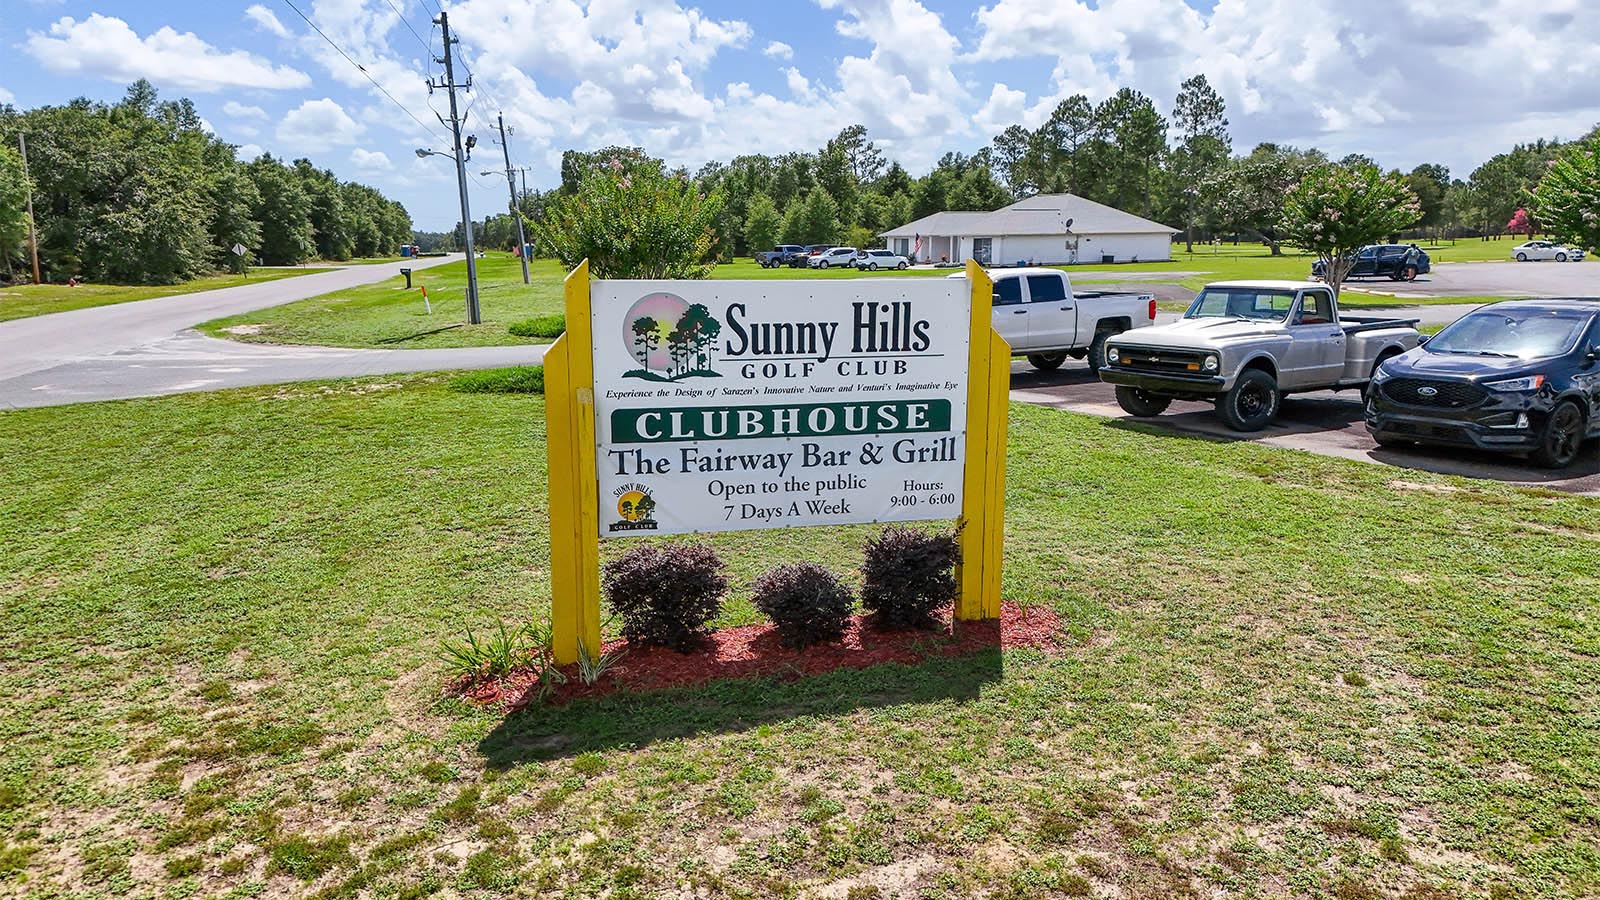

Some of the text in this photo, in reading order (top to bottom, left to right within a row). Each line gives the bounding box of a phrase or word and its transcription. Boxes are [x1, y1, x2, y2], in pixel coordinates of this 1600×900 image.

[726, 301, 931, 363] Sunny Hills
[740, 361, 907, 378] GOLF CLUB
[606, 381, 959, 400] Experience the Design of Sarazen's Innovative Nature and Venturi's Imaginative Eye
[636, 403, 930, 439] CLUBHOUSE
[607, 437, 957, 477] The Fairway Bar & Grill
[613, 483, 654, 498] SUNNY HILLS
[708, 474, 867, 500] Open to the public
[903, 479, 944, 492] Hours:
[725, 498, 851, 522] 7 Days A Week
[890, 494, 917, 508] 9:00
[929, 492, 955, 505] 6:00
